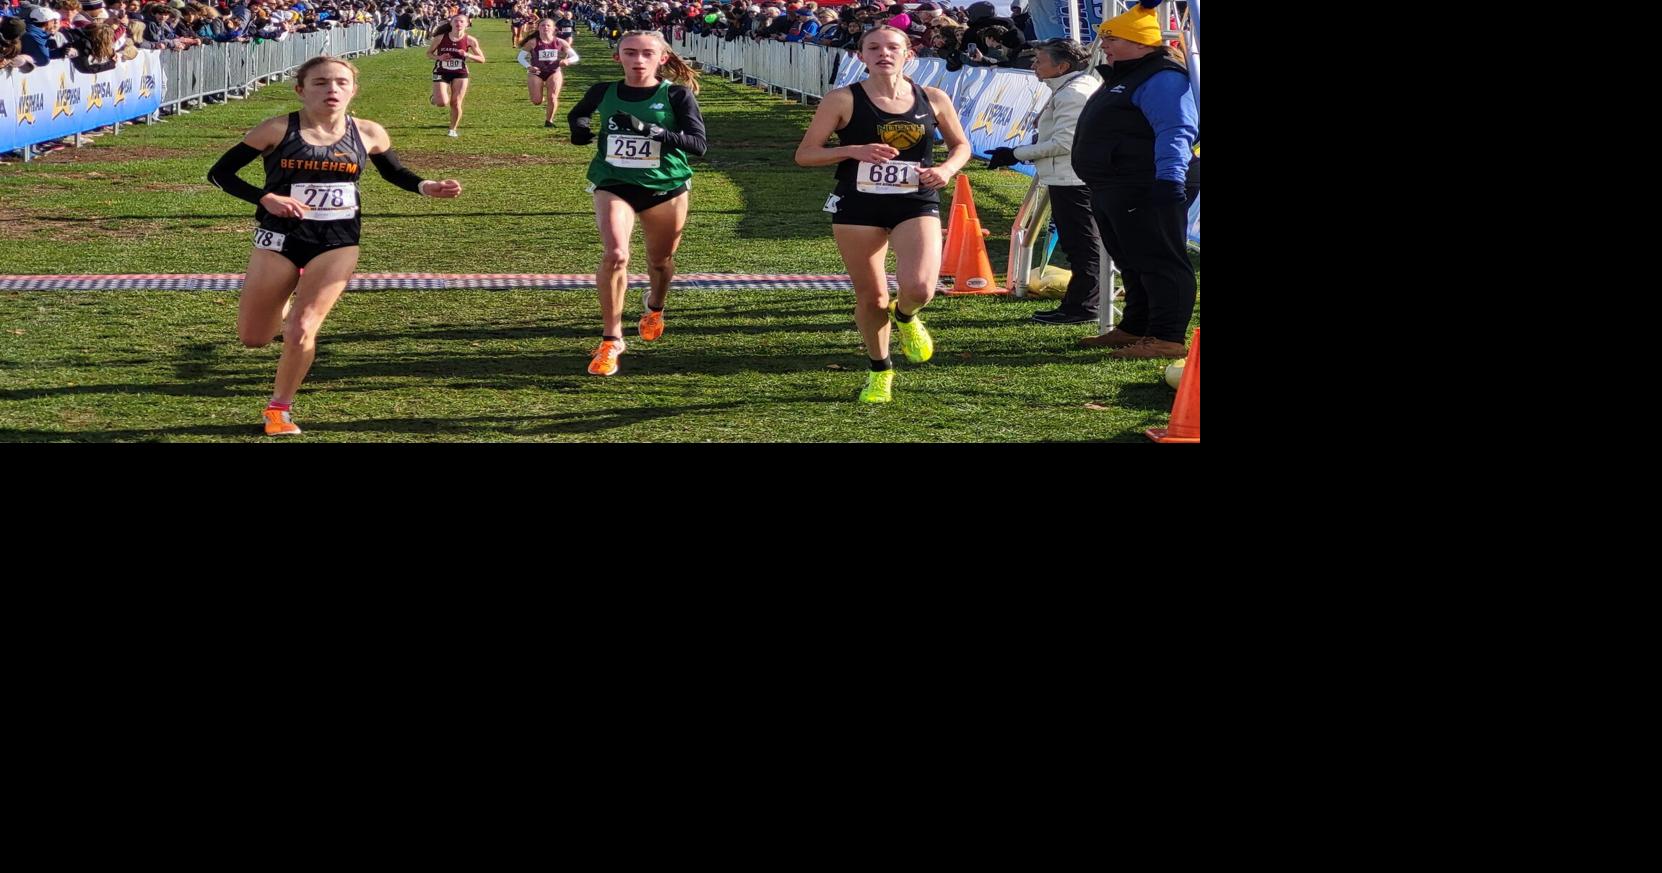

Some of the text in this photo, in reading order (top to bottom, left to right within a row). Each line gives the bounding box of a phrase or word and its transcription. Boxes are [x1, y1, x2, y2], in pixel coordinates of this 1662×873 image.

[614, 139, 652, 157] 254
[280, 158, 358, 174] BETHLEHEM
[869, 164, 910, 184] 681
[304, 188, 344, 208] 278
